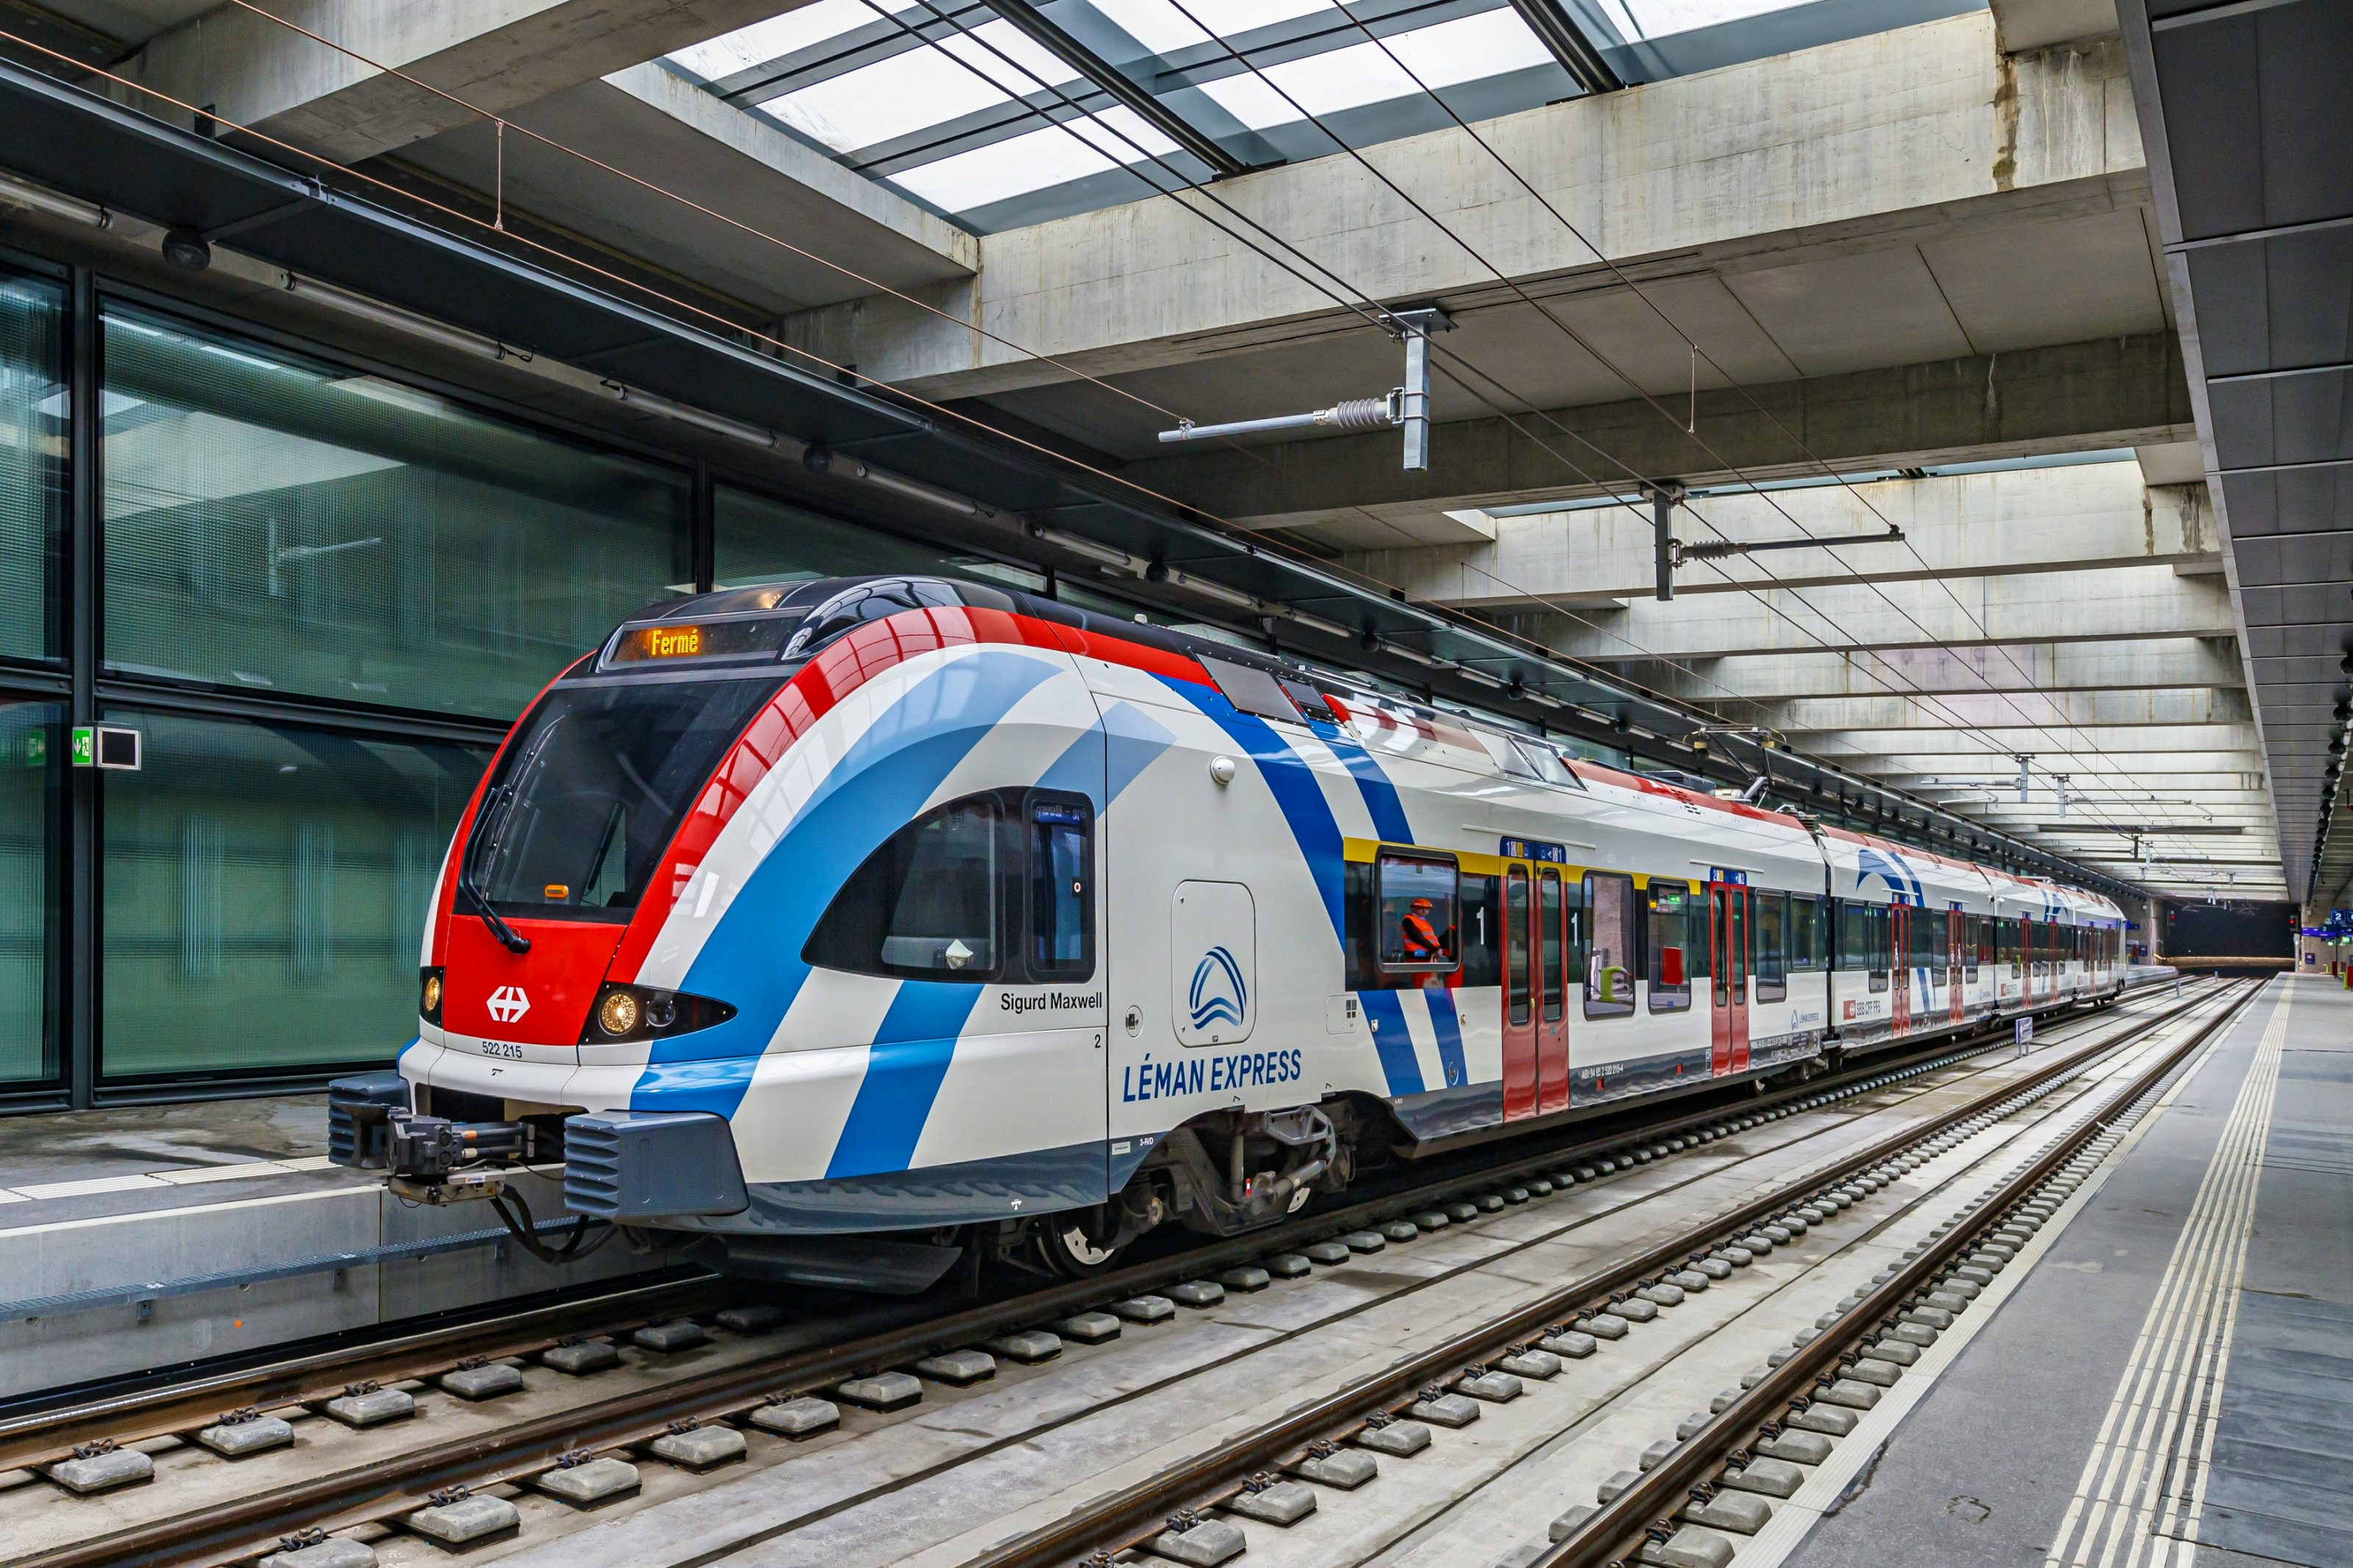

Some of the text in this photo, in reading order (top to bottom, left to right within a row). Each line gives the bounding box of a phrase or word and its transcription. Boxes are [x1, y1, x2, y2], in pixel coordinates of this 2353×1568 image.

[651, 629, 699, 657] Fermé
[1506, 840, 1510, 856] 1
[1477, 906, 1484, 945] 1
[2335, 912, 2342, 920] 2
[1571, 912, 1578, 946] 1
[1001, 992, 1103, 1015] Sigurd Maxwell
[482, 1041, 523, 1059] 522 215
[1094, 1034, 1101, 1049] 2
[1123, 1048, 1302, 1103] LÉMAN EXPRESS
